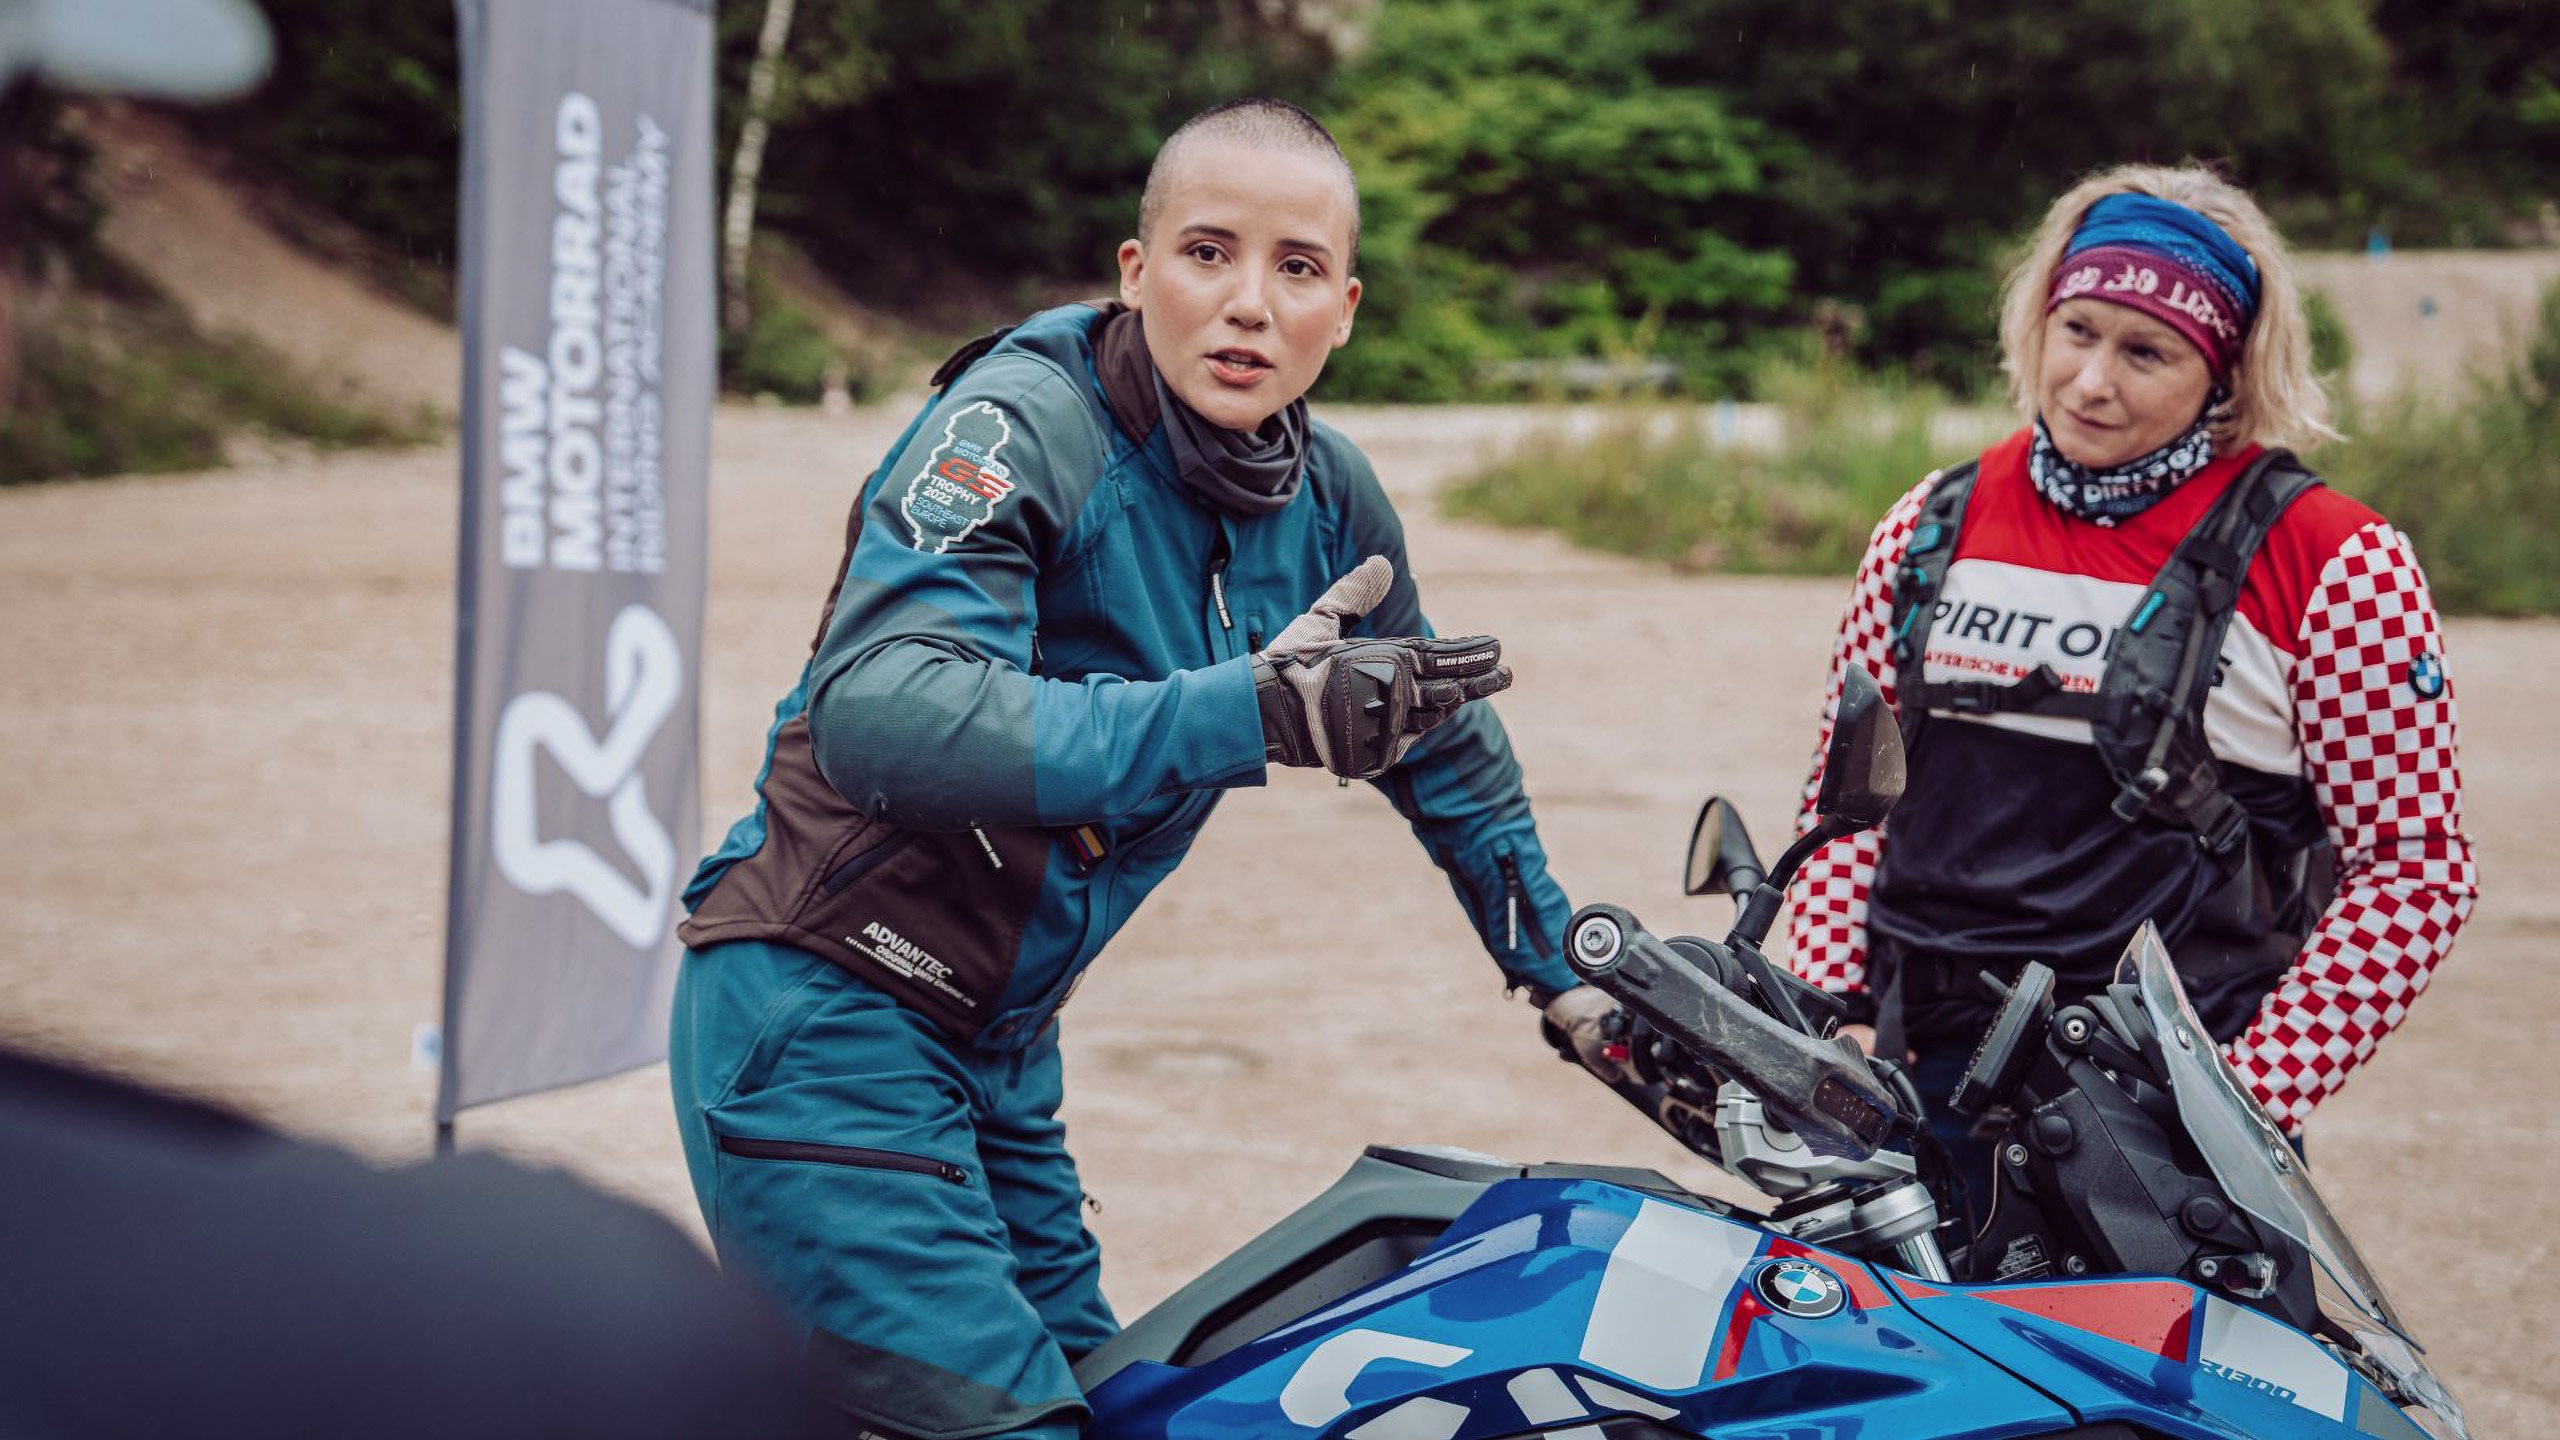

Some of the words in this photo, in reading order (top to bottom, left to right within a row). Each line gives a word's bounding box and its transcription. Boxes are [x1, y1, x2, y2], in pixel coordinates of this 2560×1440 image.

[2103, 264, 2159, 295] OF
[549, 92, 602, 572] MOTORRAD
[604, 160, 637, 573] INTERNATIONAL
[500, 346, 547, 568] BMW
[930, 475, 982, 505] TROPHY
[938, 457, 1013, 499] GS
[2083, 477, 2160, 503] DIRTY
[916, 496, 970, 527] SOUTHEAST
[922, 486, 954, 507] 2022
[911, 503, 948, 529] EUROPE
[1932, 602, 2053, 649] PIRIT
[2059, 623, 2119, 661] O
[1924, 650, 2010, 676] AYERISCHE
[862, 921, 953, 979] ADVANTEC
[875, 944, 915, 973] ORIGINAL
[1779, 1261, 1842, 1292] BMW
